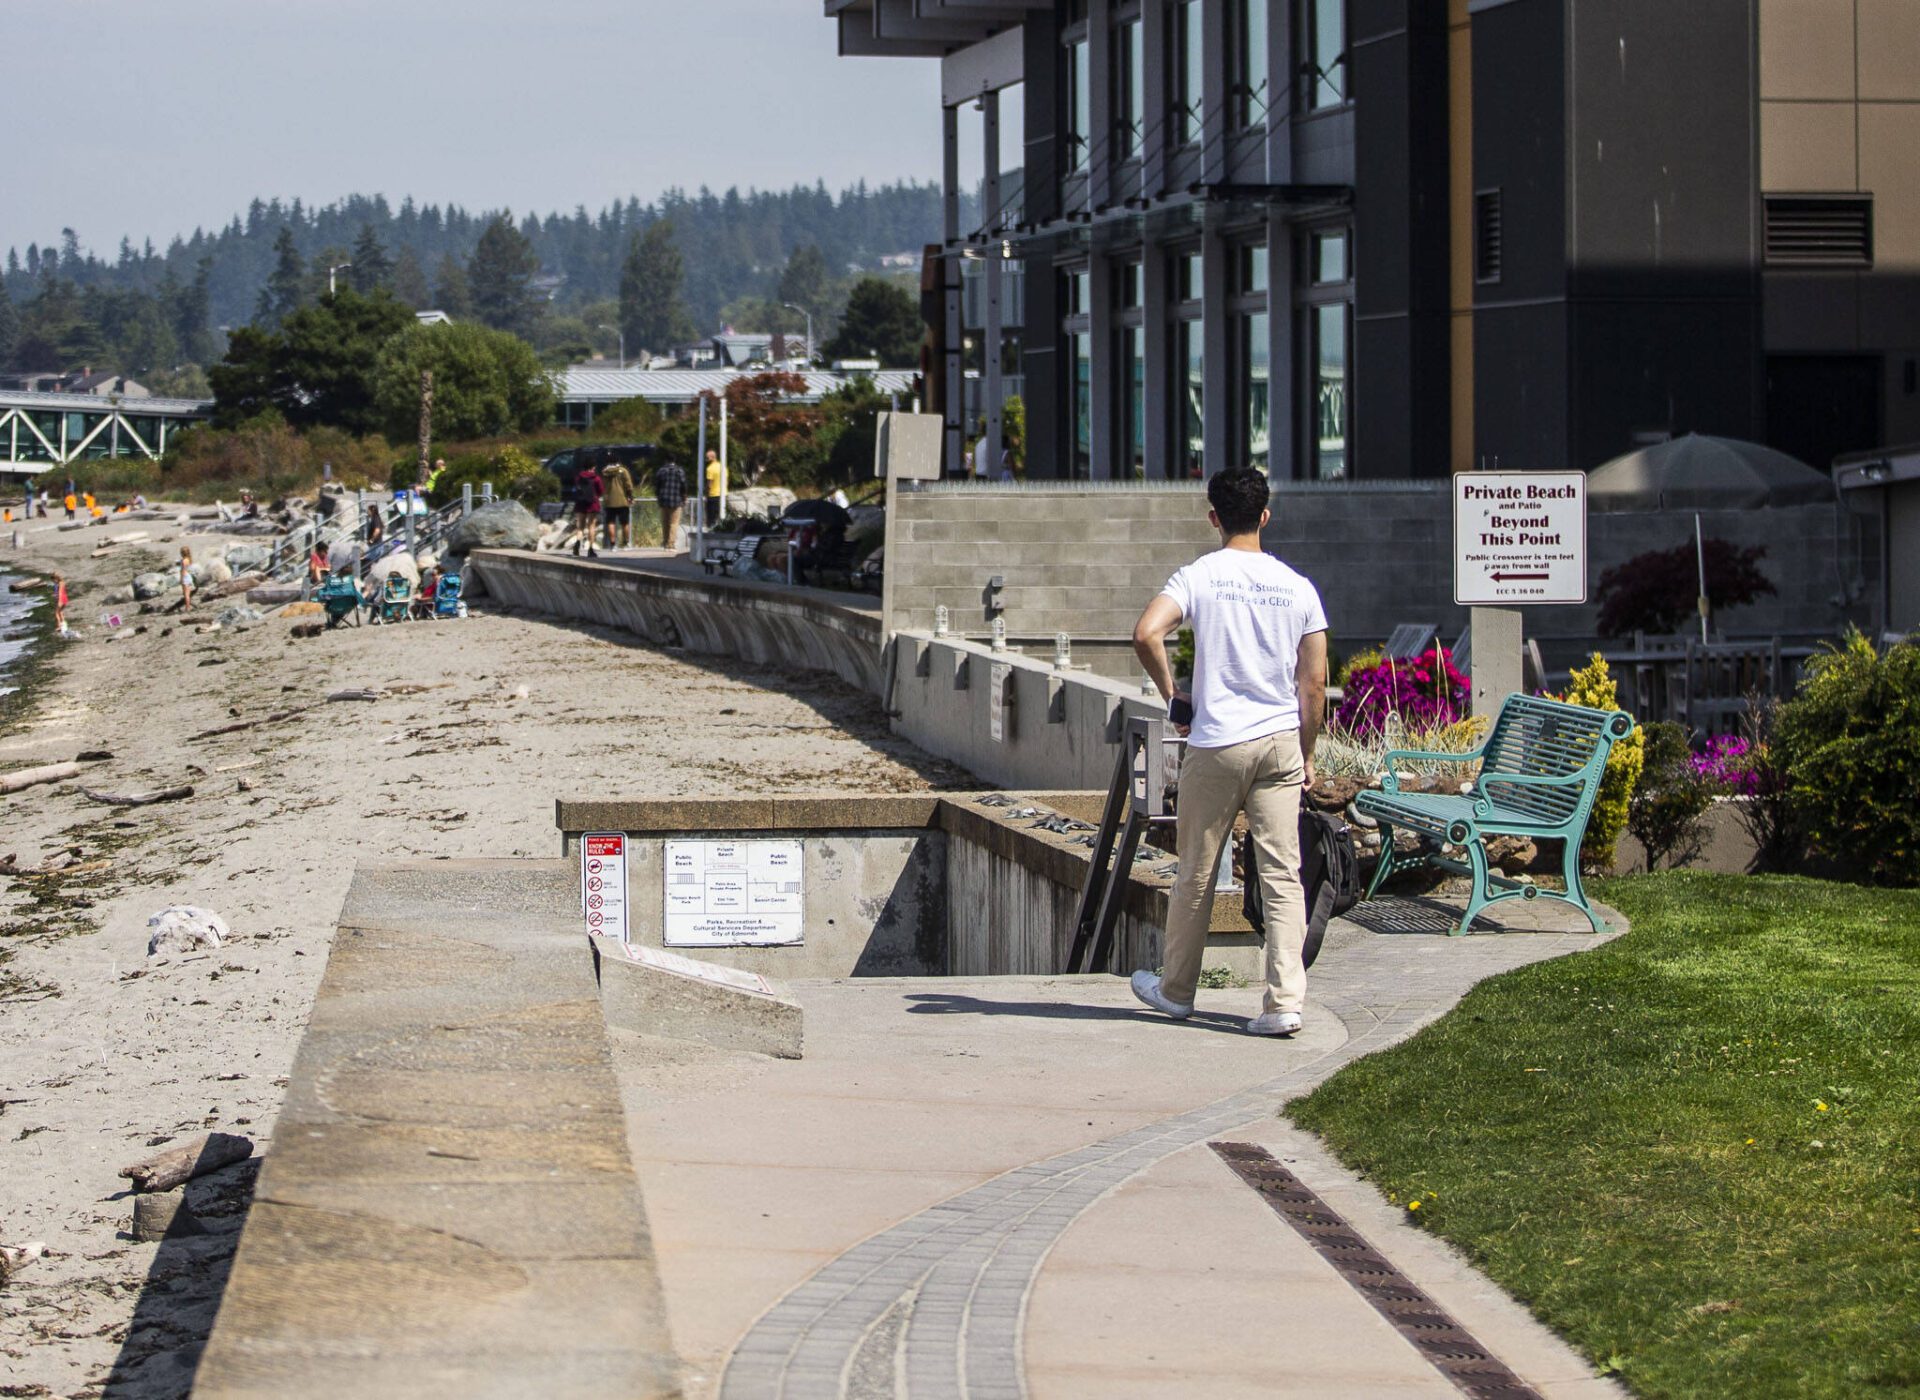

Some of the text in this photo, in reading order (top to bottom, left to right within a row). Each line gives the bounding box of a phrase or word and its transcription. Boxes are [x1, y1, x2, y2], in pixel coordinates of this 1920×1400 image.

[1464, 485, 1576, 499] Private Beach
[1491, 516, 1549, 531] Beyond
[1480, 533, 1561, 546] This Point
